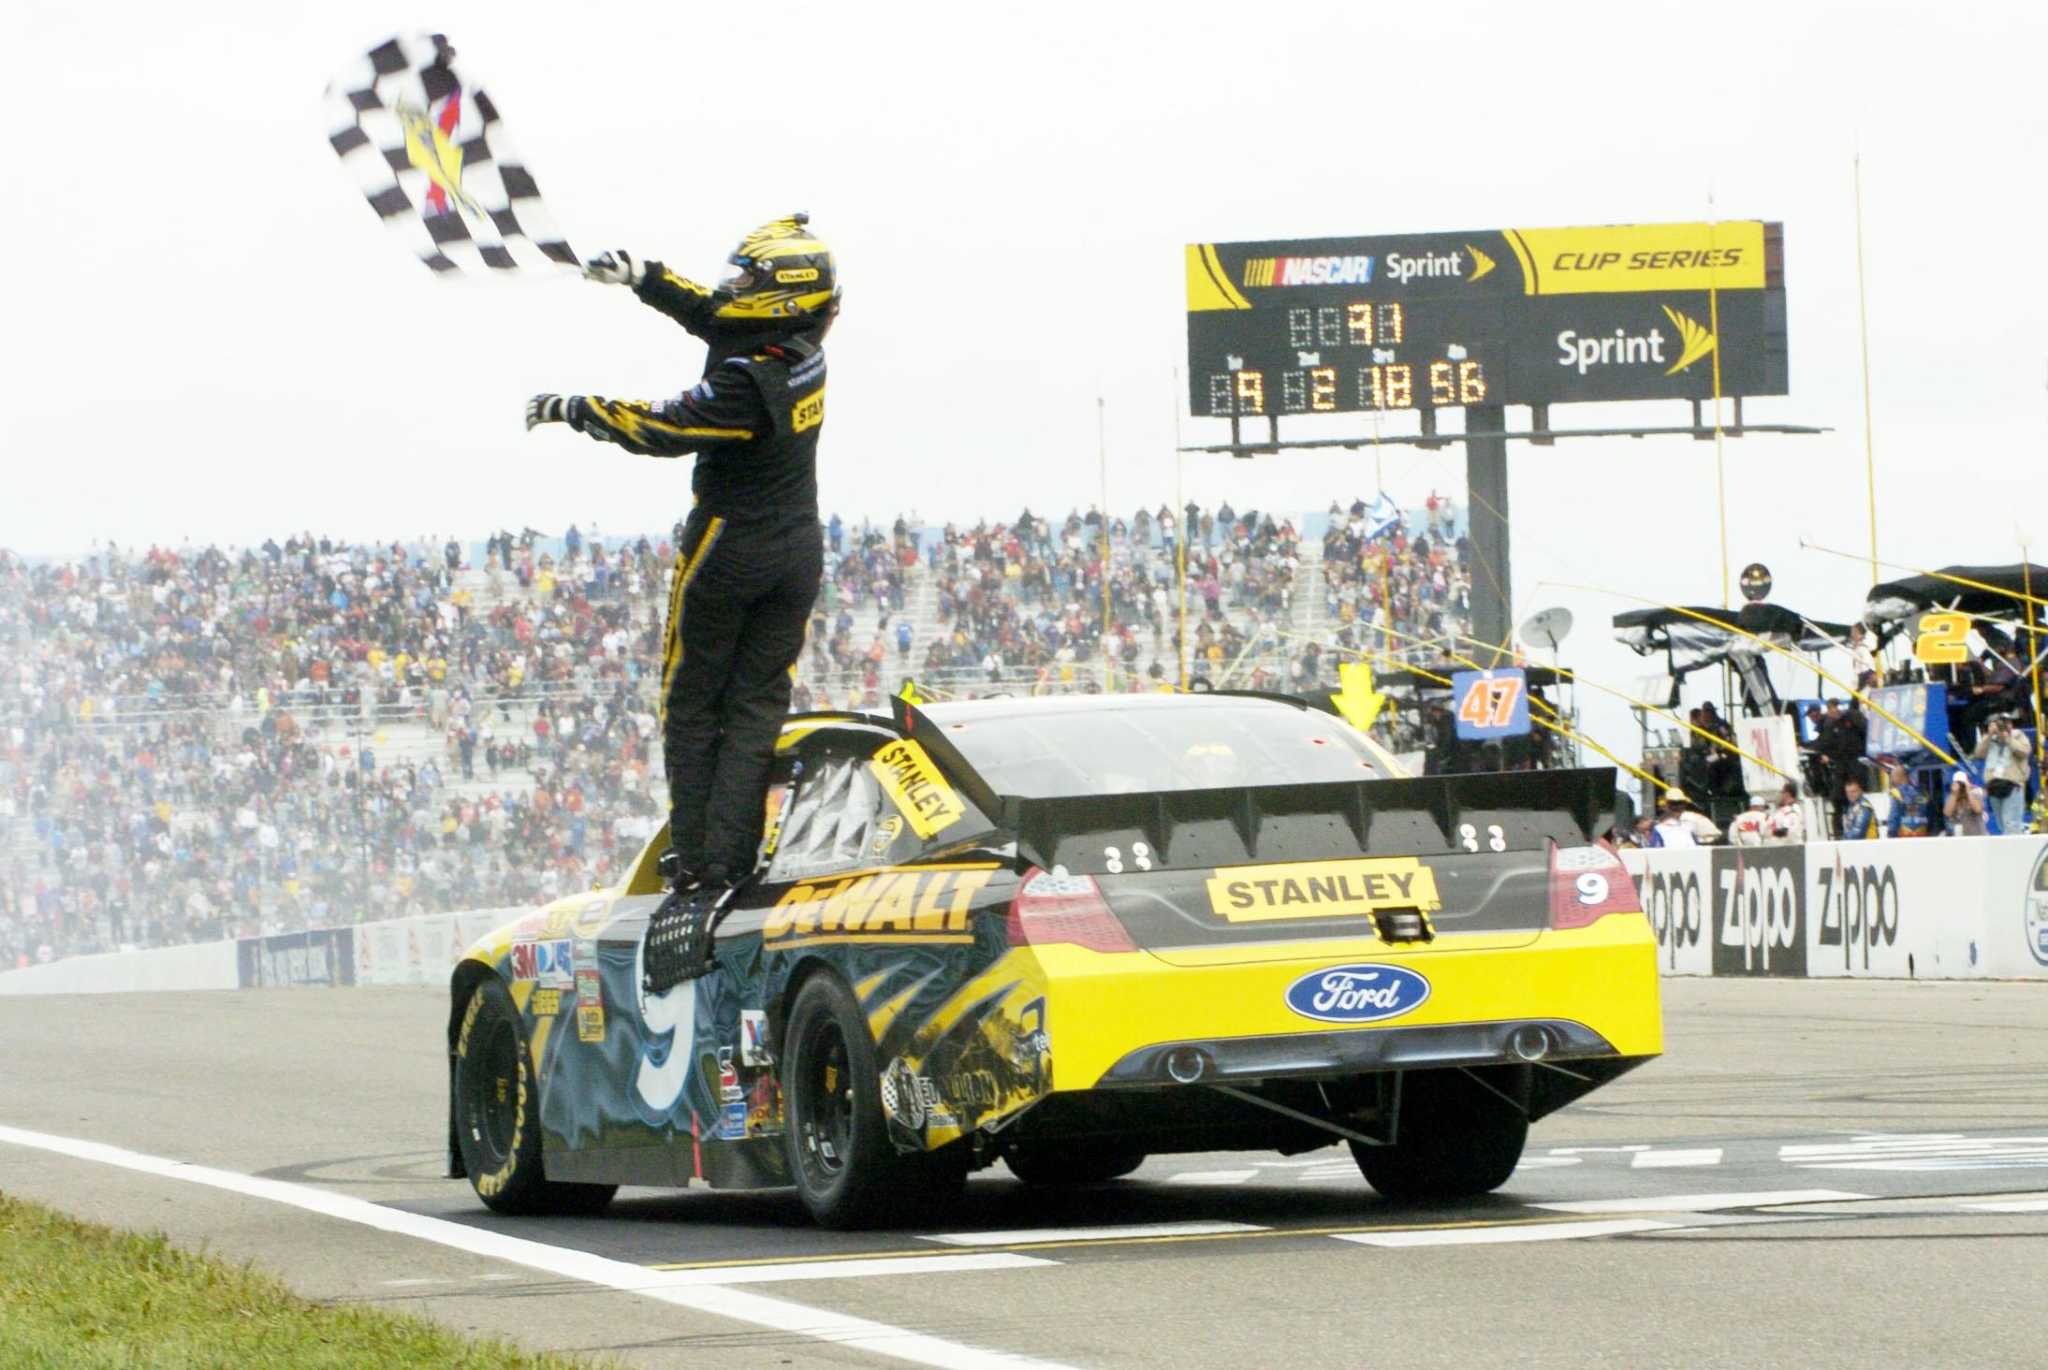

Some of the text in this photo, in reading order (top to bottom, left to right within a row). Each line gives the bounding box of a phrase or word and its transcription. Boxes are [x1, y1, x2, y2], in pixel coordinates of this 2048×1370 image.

[1282, 248, 1743, 285] NASCAR Sprint CUP SERIES
[1557, 328, 1665, 374] Sprint
[1312, 368, 1335, 410] 2
[1371, 365, 1411, 407] 18
[1431, 362, 1486, 404] 56
[1916, 613, 1971, 664] 2
[1459, 677, 1523, 727] 47
[882, 746, 950, 821] STANLEY
[1227, 872, 1414, 908] STANLEY
[1576, 872, 1608, 904] 9
[1632, 856, 1700, 970] ippo
[512, 943, 538, 979] 3M
[1312, 971, 1401, 1012] Ford
[635, 928, 696, 1110] 9
